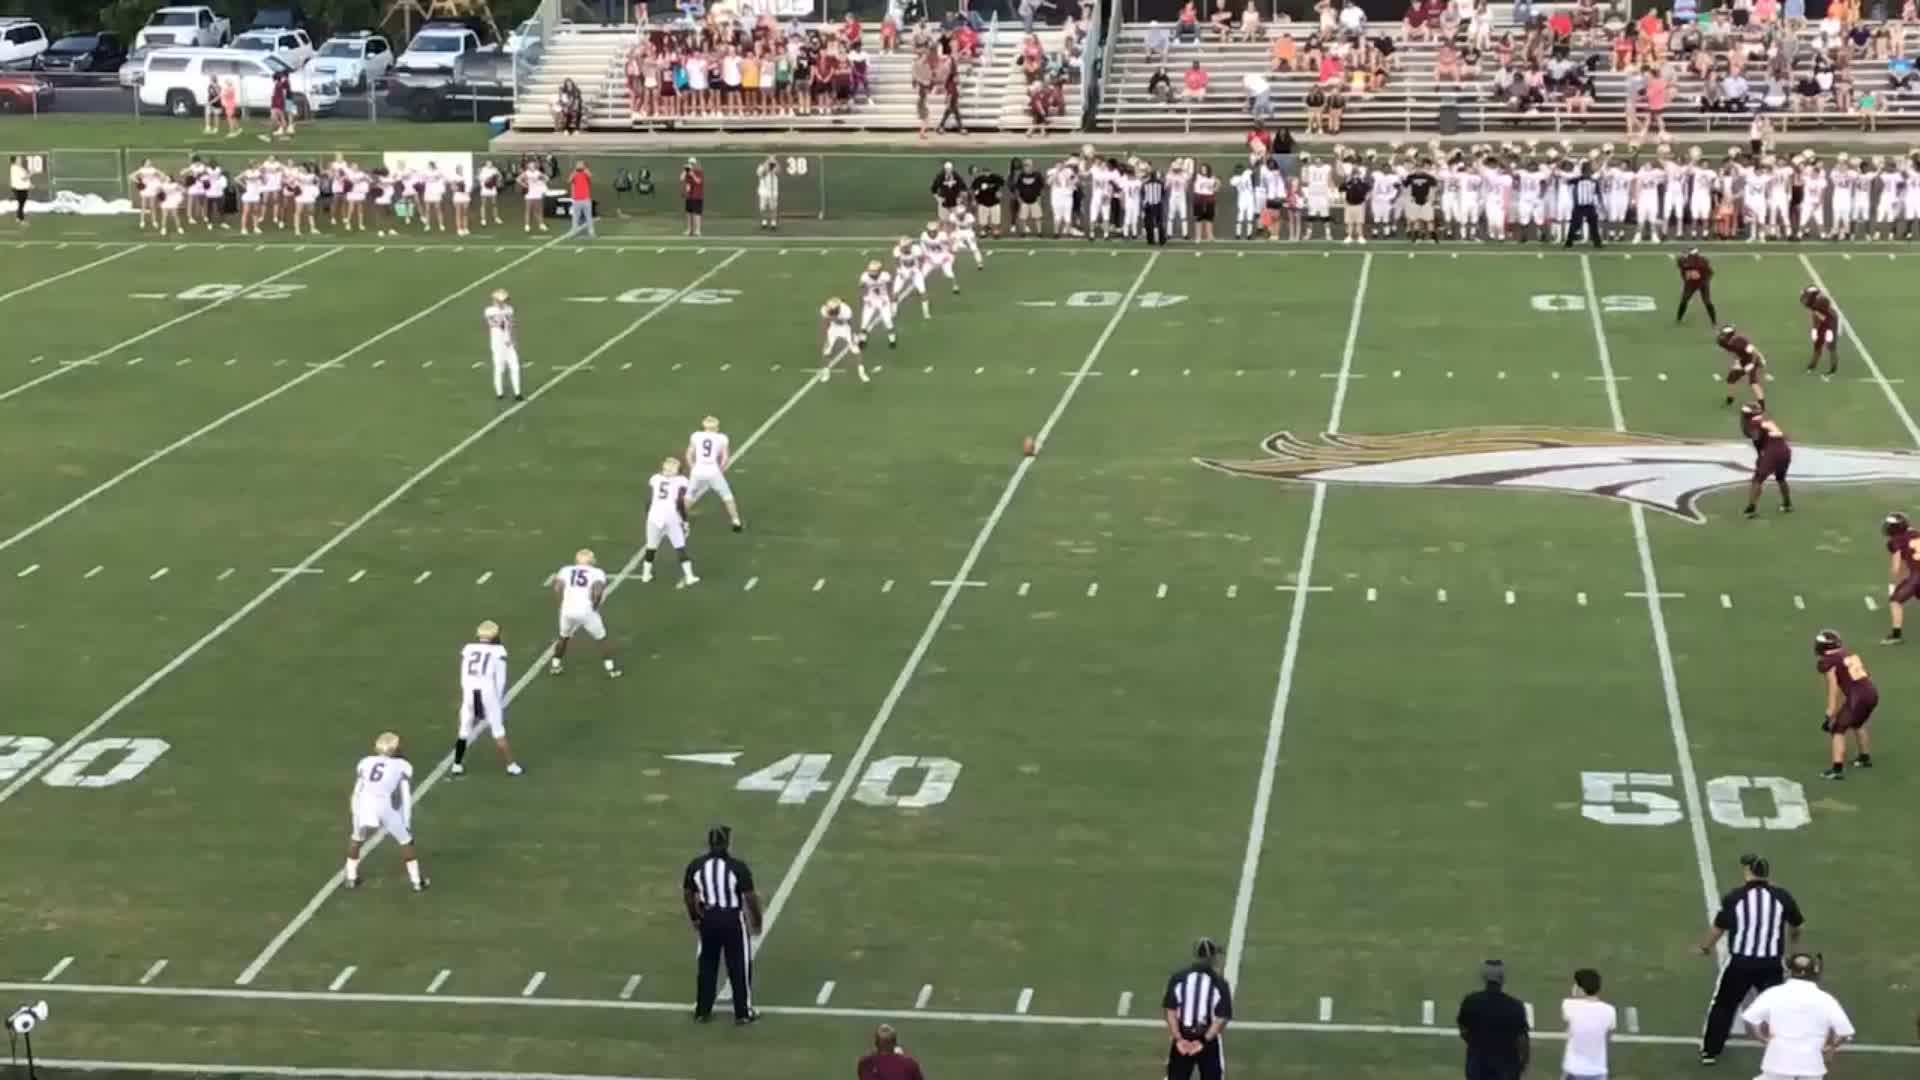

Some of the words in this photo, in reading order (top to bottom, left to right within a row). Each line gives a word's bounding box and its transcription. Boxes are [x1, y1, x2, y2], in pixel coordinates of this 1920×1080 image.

[702, 438, 713, 457] 9
[659, 481, 671, 500] 5
[571, 569, 588, 588] 15
[468, 651, 491, 676] 21
[369, 763, 385, 783] 6
[736, 753, 963, 807] 40
[1581, 771, 1812, 830] 50
